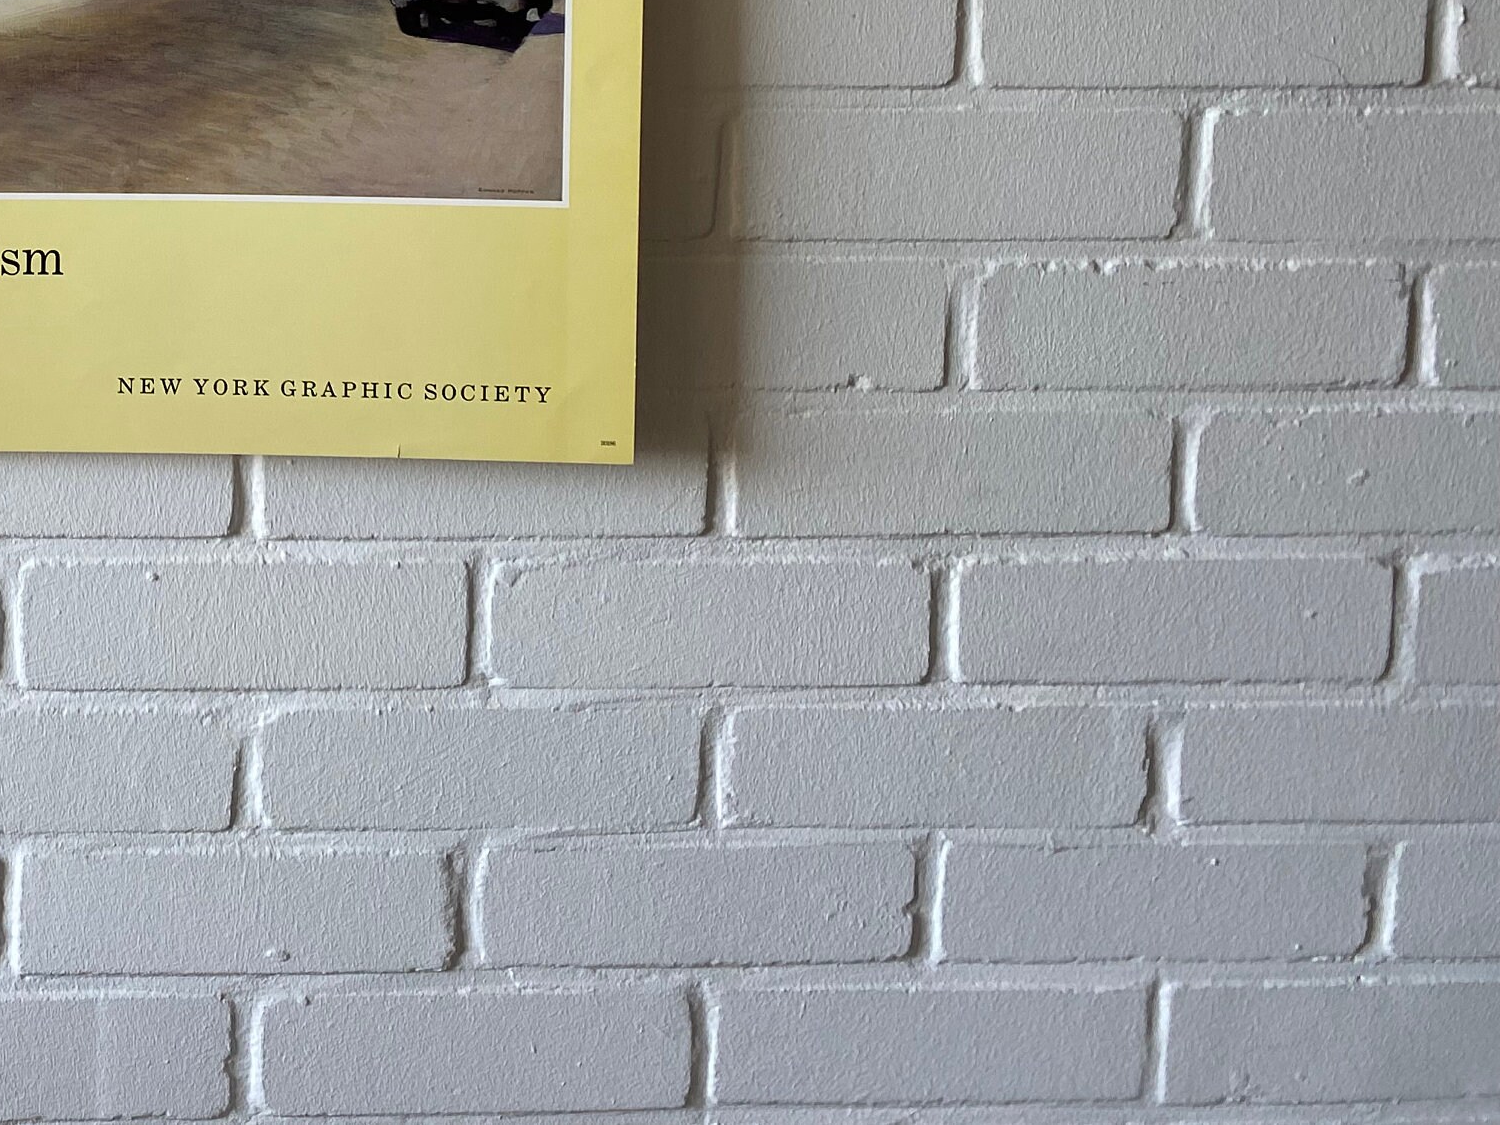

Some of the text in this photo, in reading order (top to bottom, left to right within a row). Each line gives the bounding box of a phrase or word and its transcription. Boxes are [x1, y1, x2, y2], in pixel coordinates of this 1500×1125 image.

[117, 377, 552, 404] NEW YORK GRAPHIC SOCIETY
